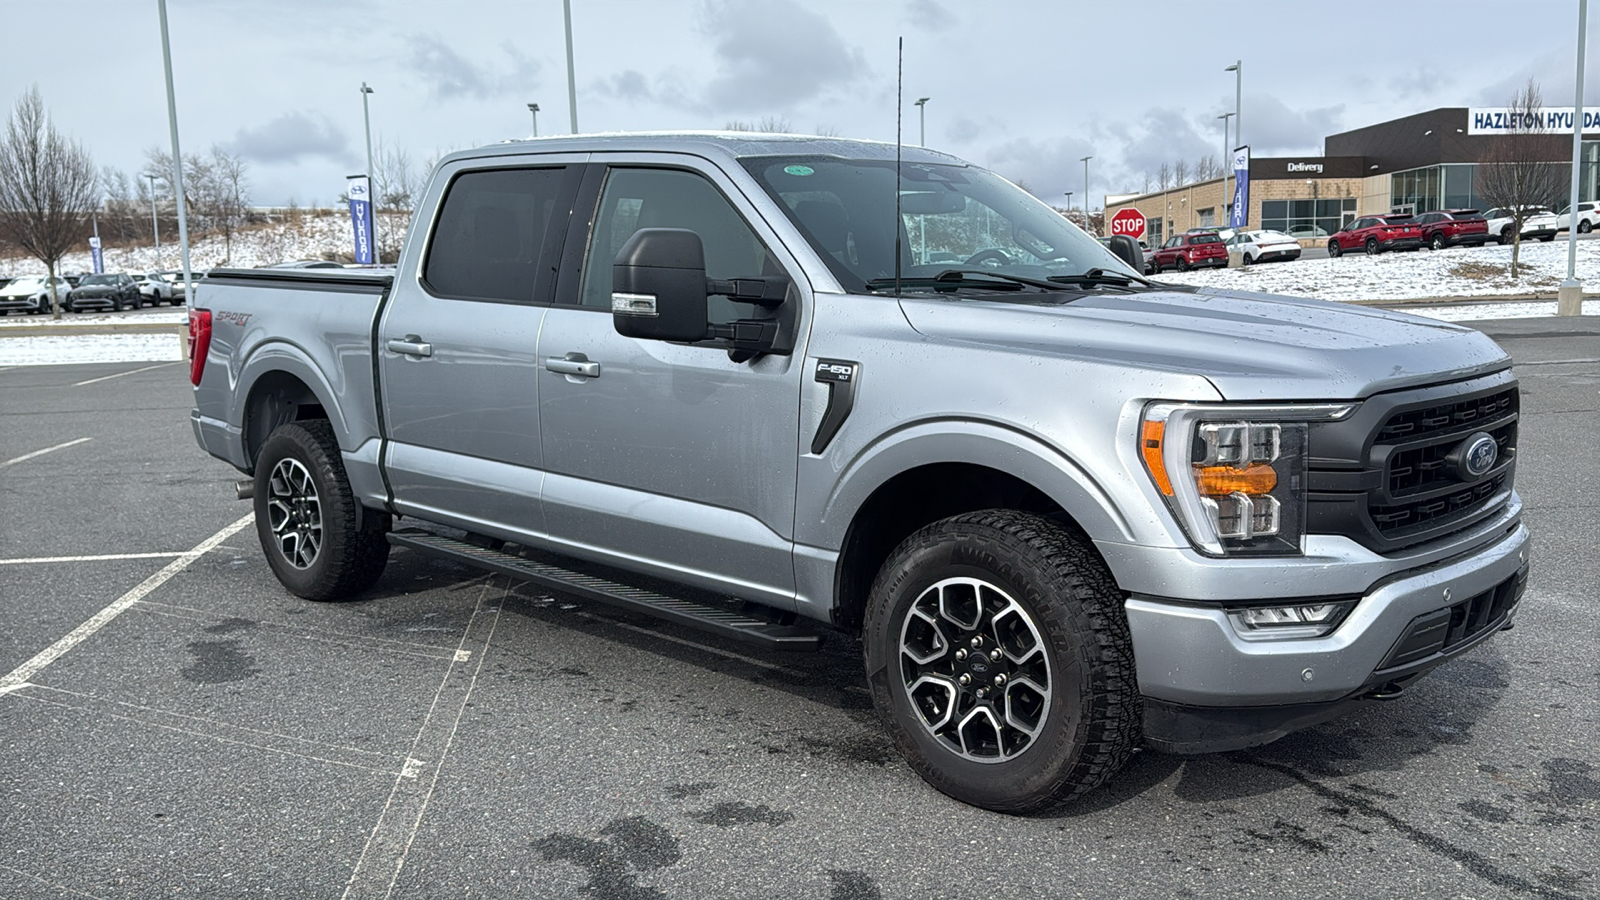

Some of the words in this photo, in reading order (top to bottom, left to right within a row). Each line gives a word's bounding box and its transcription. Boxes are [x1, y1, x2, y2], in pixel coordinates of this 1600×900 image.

[1475, 113, 1544, 129] HAZLETON
[1548, 112, 1600, 128] HYUDA
[1287, 162, 1323, 174] Delivery
[1114, 218, 1143, 232] STOP
[355, 203, 367, 261] HYUNDAI
[215, 311, 253, 324] SPORT
[817, 363, 852, 374] F-150
